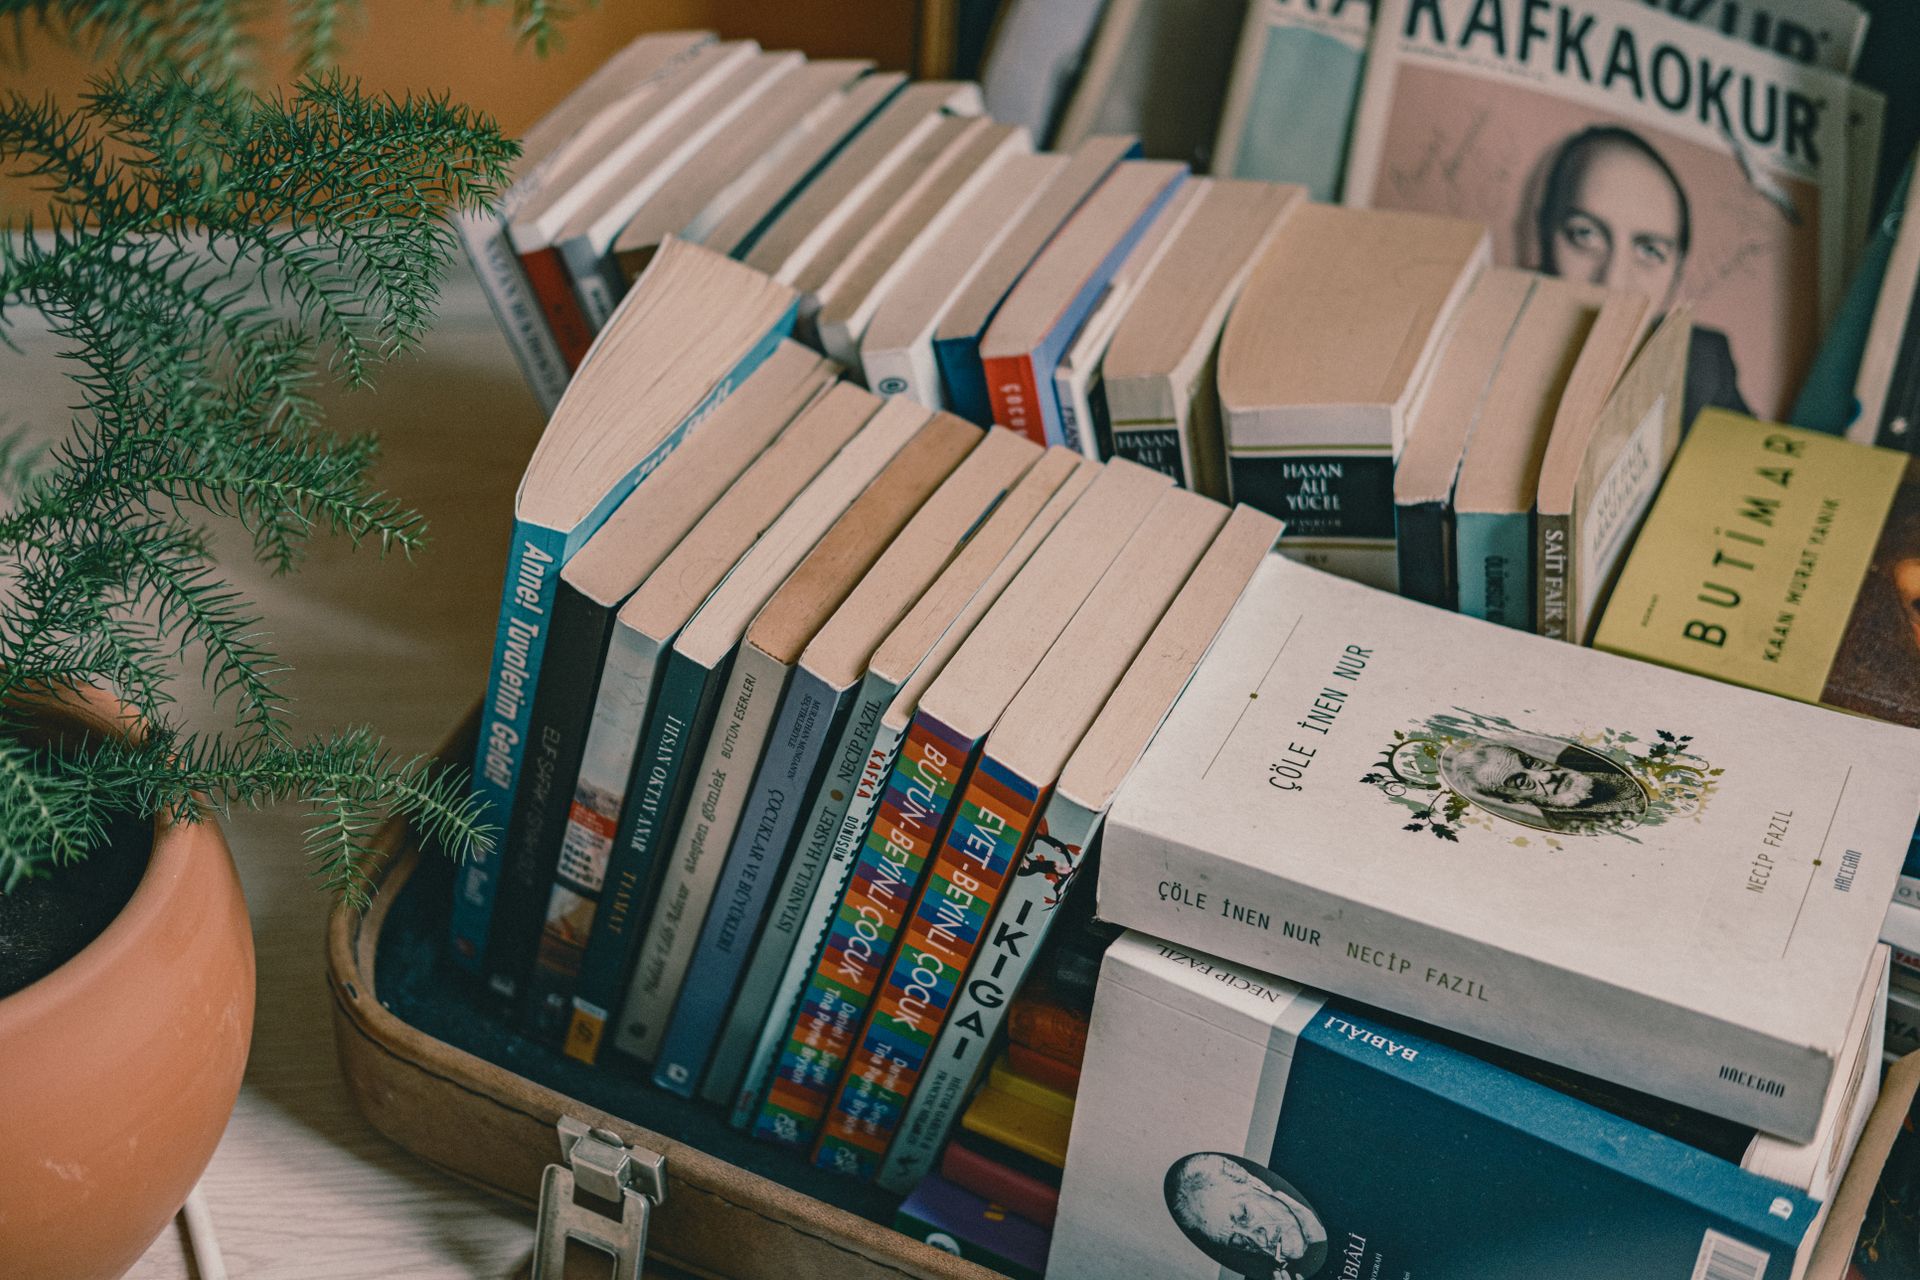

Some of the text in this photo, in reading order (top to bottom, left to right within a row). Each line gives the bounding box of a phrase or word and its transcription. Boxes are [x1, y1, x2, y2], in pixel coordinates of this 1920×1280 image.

[1404, 0, 1820, 166] KAFKAOKUR
[1282, 463, 1343, 479] HASAN
[1543, 528, 1568, 573] SAİT
[1682, 434, 1806, 648] BUTİMAR
[1543, 576, 1569, 618] FAİK
[483, 540, 554, 790] Anne! Tuvaletim Geldi!
[1762, 611, 1795, 664] KAAN
[656, 714, 686, 766] İHSAN
[721, 720, 739, 759] BÜTÜN
[837, 698, 882, 784] NECİP FAZIL
[1268, 643, 1374, 792] ÇÖLE İNEN NUR
[639, 764, 667, 817] OKTAY
[702, 767, 728, 823] gömlek
[856, 748, 887, 800] KAFKA
[751, 787, 786, 861] ÇOCUKLAR
[1746, 810, 1793, 894] NECİP FAZIL
[740, 862, 757, 881] VE
[776, 806, 839, 934] İSTANBULA HASRET
[836, 904, 883, 984] ÇOCUK
[1155, 942, 1281, 1004] NECİP FAZIL
[1157, 880, 1490, 1003] ÇÖLE İNEN NUR NECİP FAZIL
[891, 950, 945, 1033] ÇOCUK
[952, 900, 1034, 1061] IKIGAI
[1322, 1015, 1420, 1064] BÂBIÂLİ
